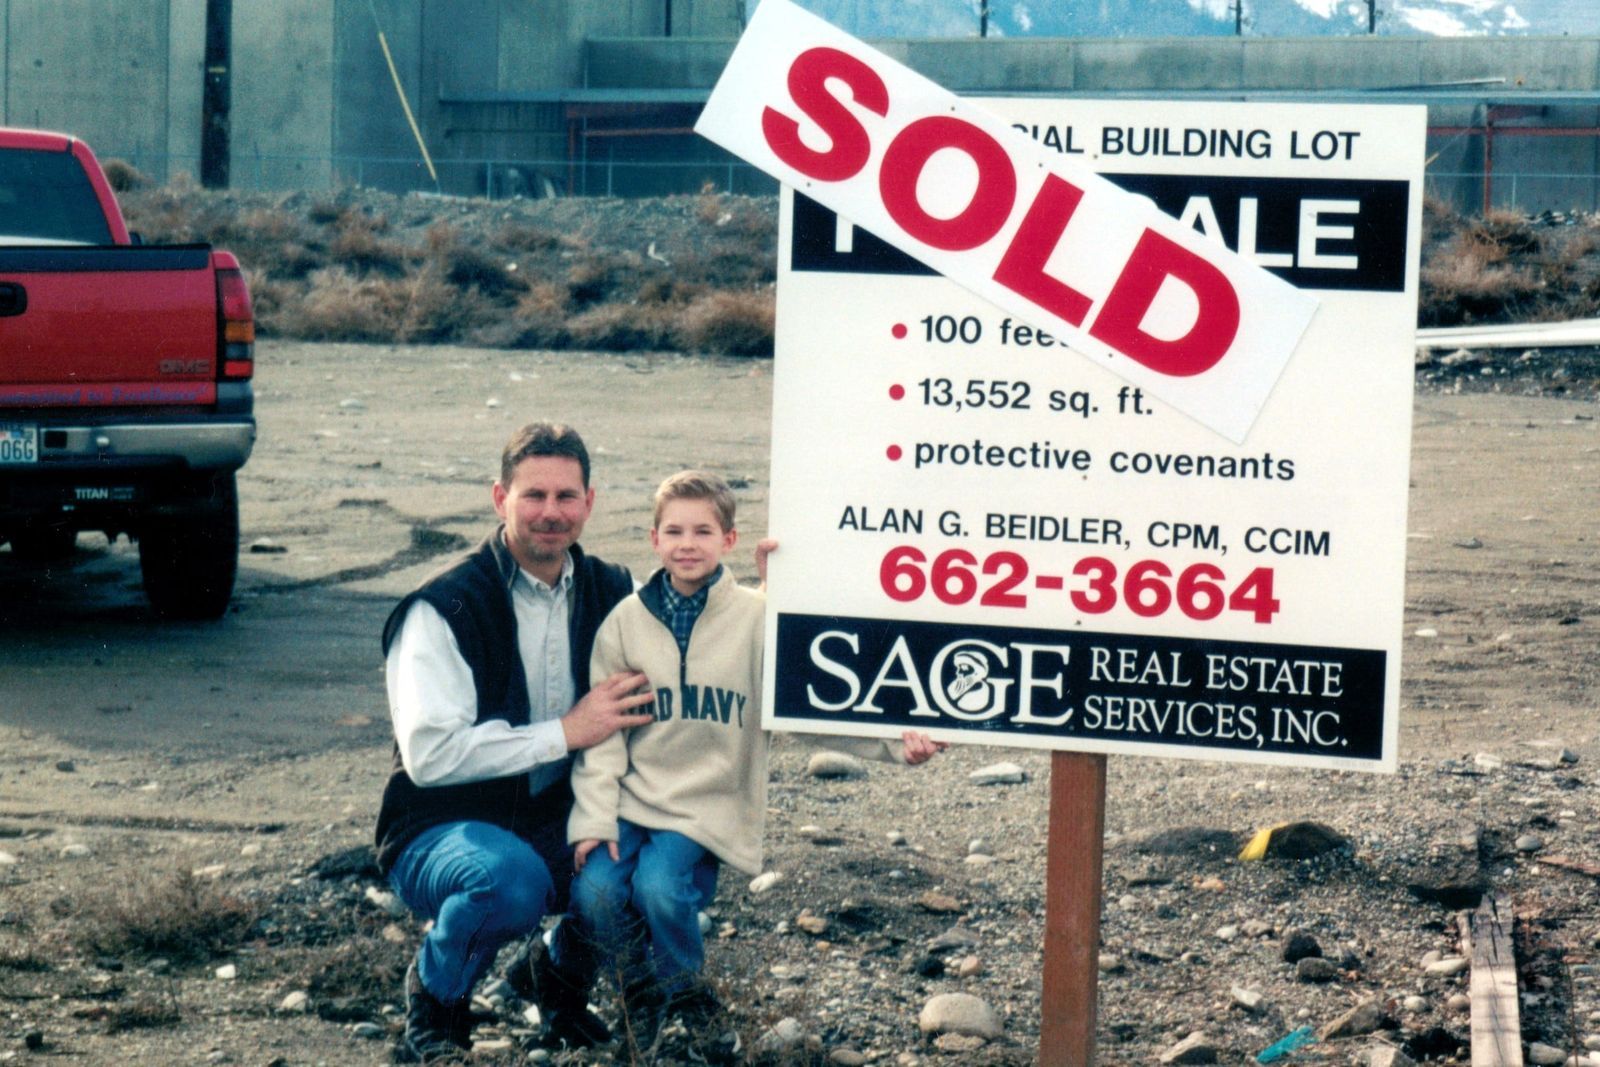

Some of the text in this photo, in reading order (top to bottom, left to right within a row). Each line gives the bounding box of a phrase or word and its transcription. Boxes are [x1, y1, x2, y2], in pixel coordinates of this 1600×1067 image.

[1101, 126, 1272, 160] BUILDING
[1290, 130, 1361, 161] LOT
[762, 47, 1240, 377] SOLD
[1128, 192, 1360, 269] ALE
[920, 315, 1068, 348] 100 fee
[918, 378, 1153, 418] 13,552 sq. ft.
[915, 439, 1295, 481] protective covenants
[75, 487, 109, 499] TITAN
[838, 505, 1331, 557] ALAN G. BEIDLER, CPM, CCIM
[880, 545, 1281, 624] 662-3664
[806, 629, 1074, 727] SAGE
[1090, 647, 1343, 697] REAL ESTATE
[680, 684, 746, 728] NAVY
